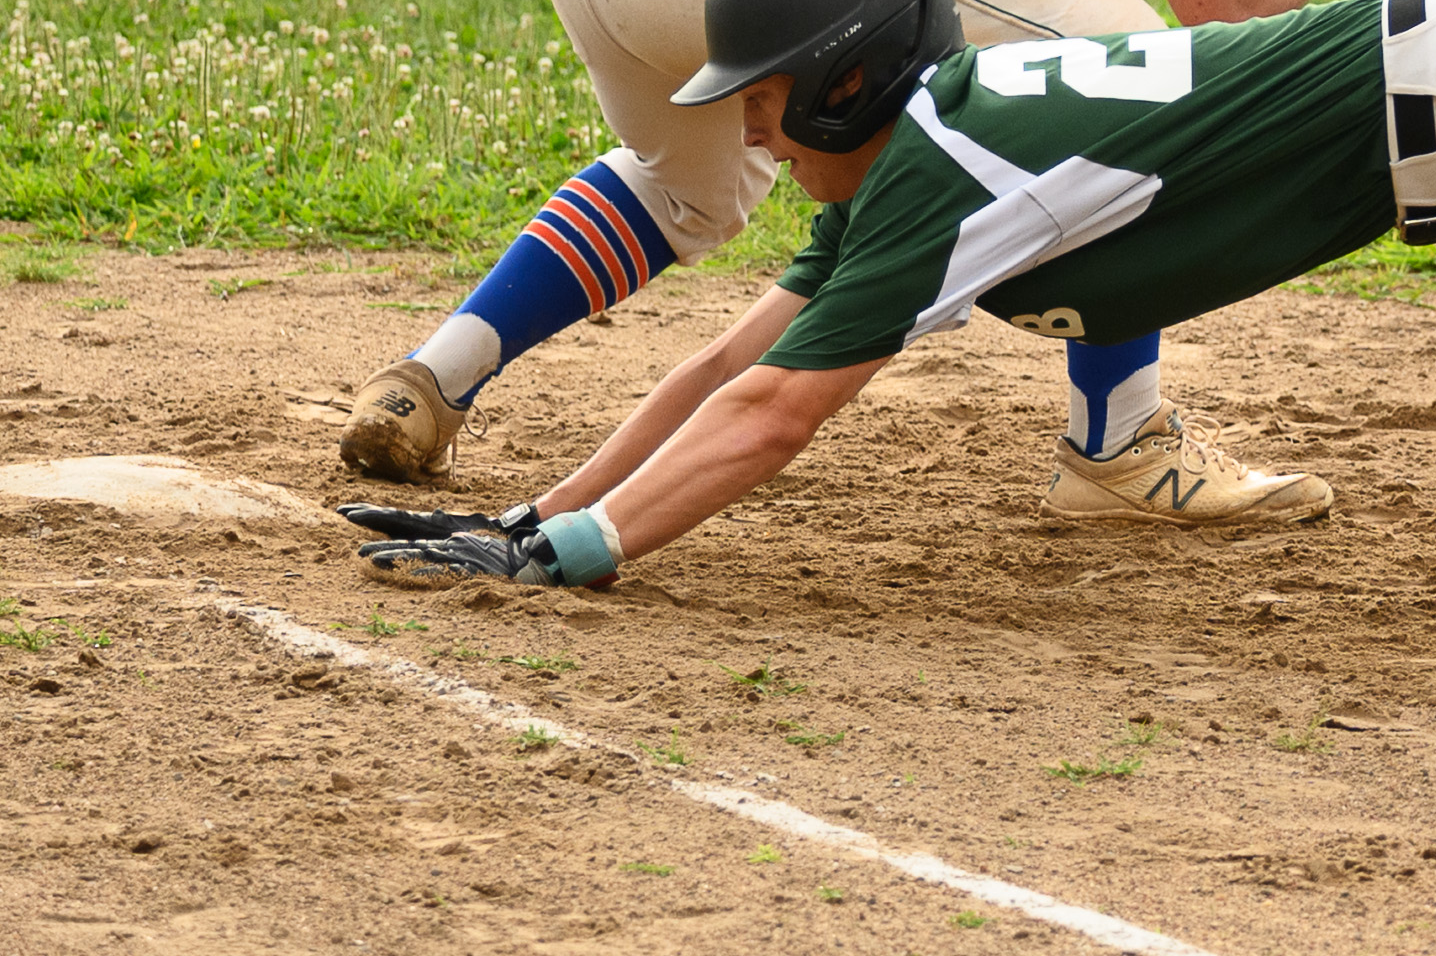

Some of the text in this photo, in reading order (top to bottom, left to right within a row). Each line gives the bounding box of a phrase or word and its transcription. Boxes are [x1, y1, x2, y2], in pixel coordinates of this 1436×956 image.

[976, 29, 1193, 104] 2
[1010, 307, 1086, 338] B
[1144, 468, 1206, 511] N
